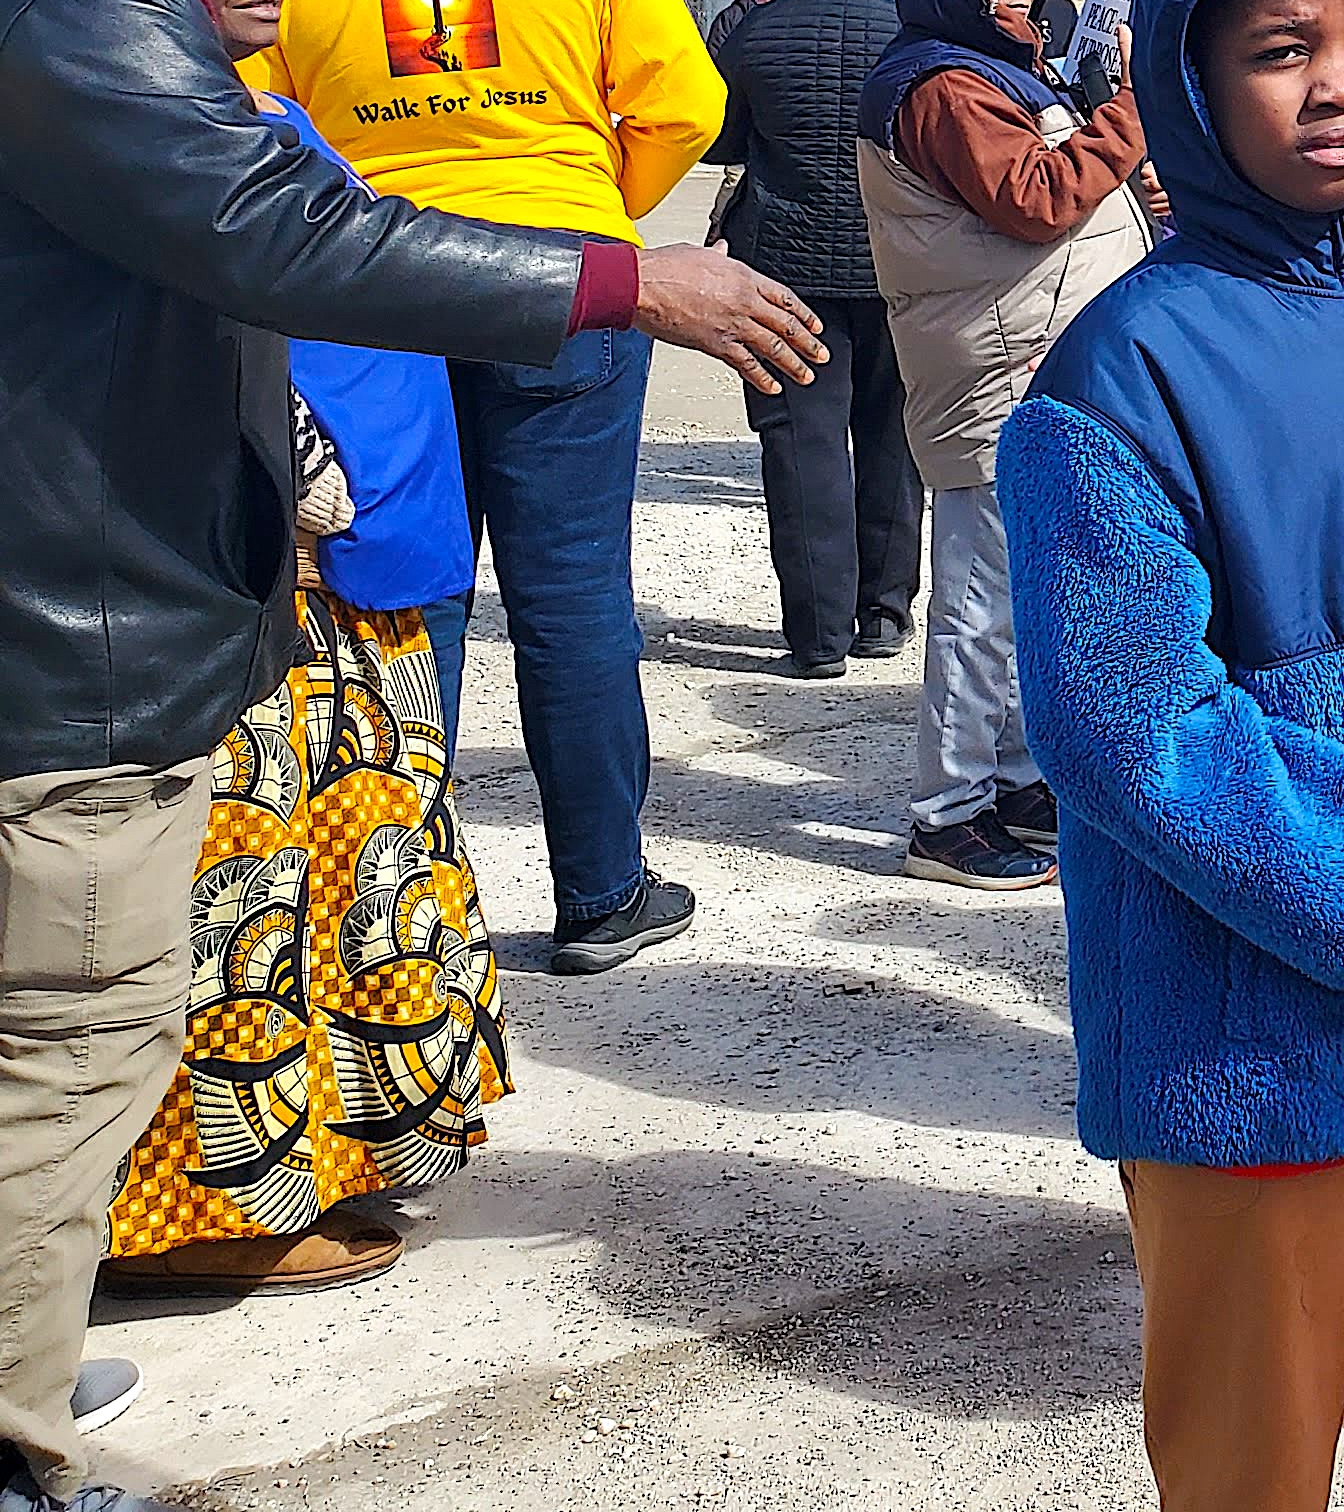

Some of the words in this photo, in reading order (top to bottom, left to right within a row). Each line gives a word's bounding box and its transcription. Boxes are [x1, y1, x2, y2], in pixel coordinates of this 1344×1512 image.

[1084, 2, 1119, 35] PEACE
[352, 96, 421, 125] Walk
[426, 93, 471, 115] For
[480, 87, 548, 109] Jesus
